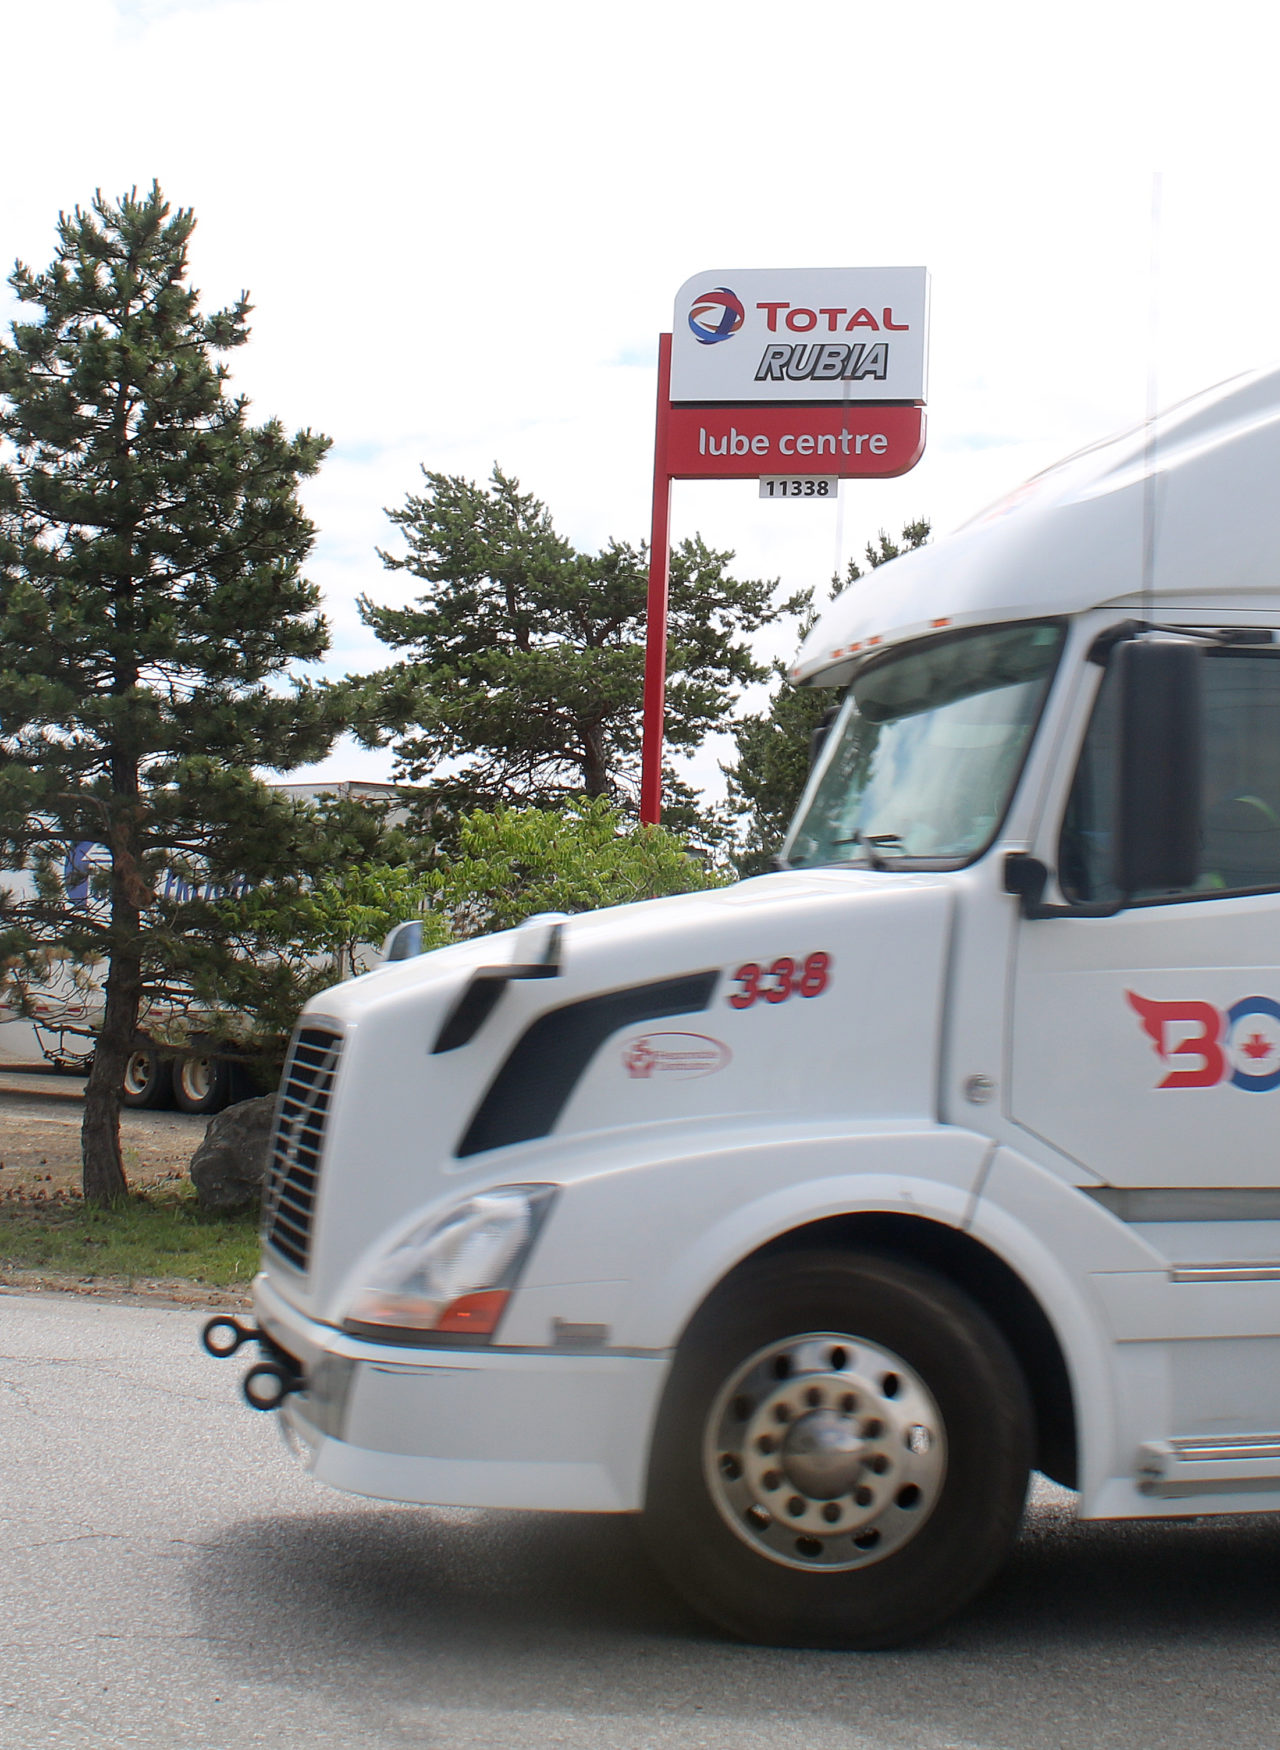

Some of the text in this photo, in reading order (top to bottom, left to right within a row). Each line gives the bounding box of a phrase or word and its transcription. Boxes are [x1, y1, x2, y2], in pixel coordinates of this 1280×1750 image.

[756, 302, 909, 332] TOTAL
[754, 343, 889, 381] RUBIA
[699, 427, 888, 456] lube centre
[766, 480, 829, 496] 11338
[728, 951, 831, 1010] 338
